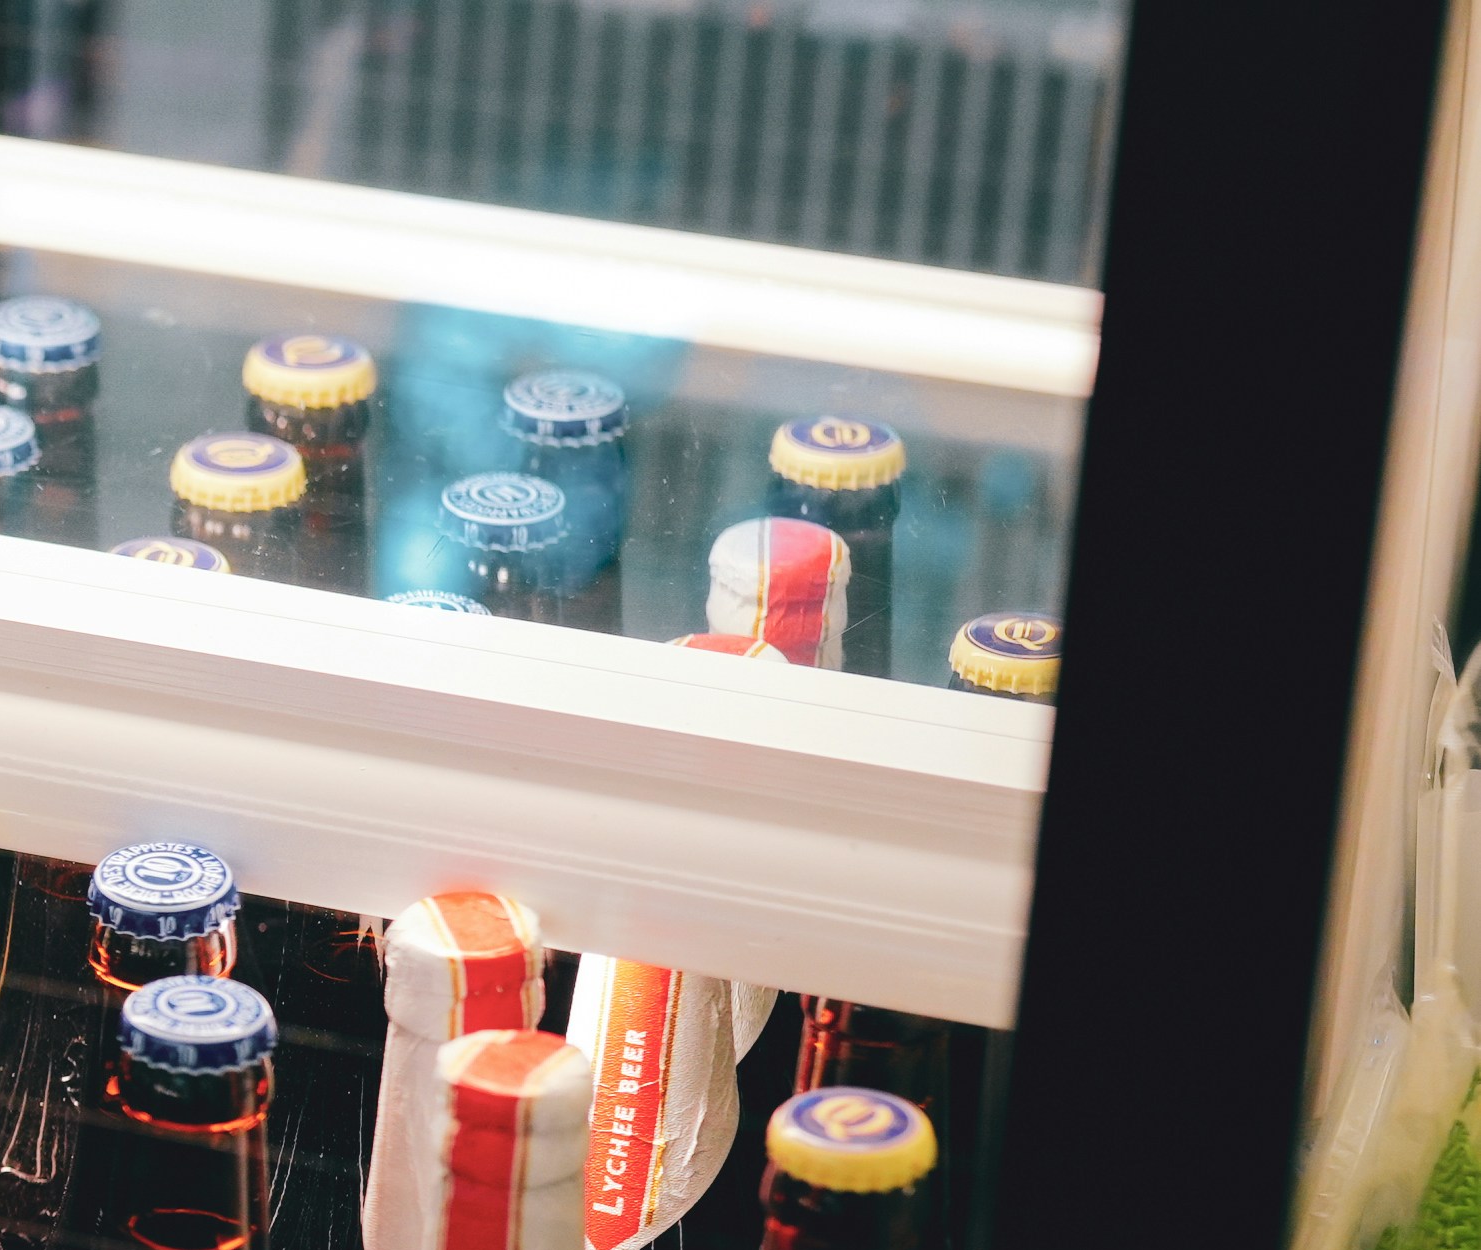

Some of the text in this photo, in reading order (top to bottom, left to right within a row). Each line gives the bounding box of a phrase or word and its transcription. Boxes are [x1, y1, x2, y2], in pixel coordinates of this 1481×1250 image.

[106, 843, 194, 868] TRAPPISTES
[158, 916, 177, 937] 10
[593, 1028, 647, 1217] LYCHEE BEER
